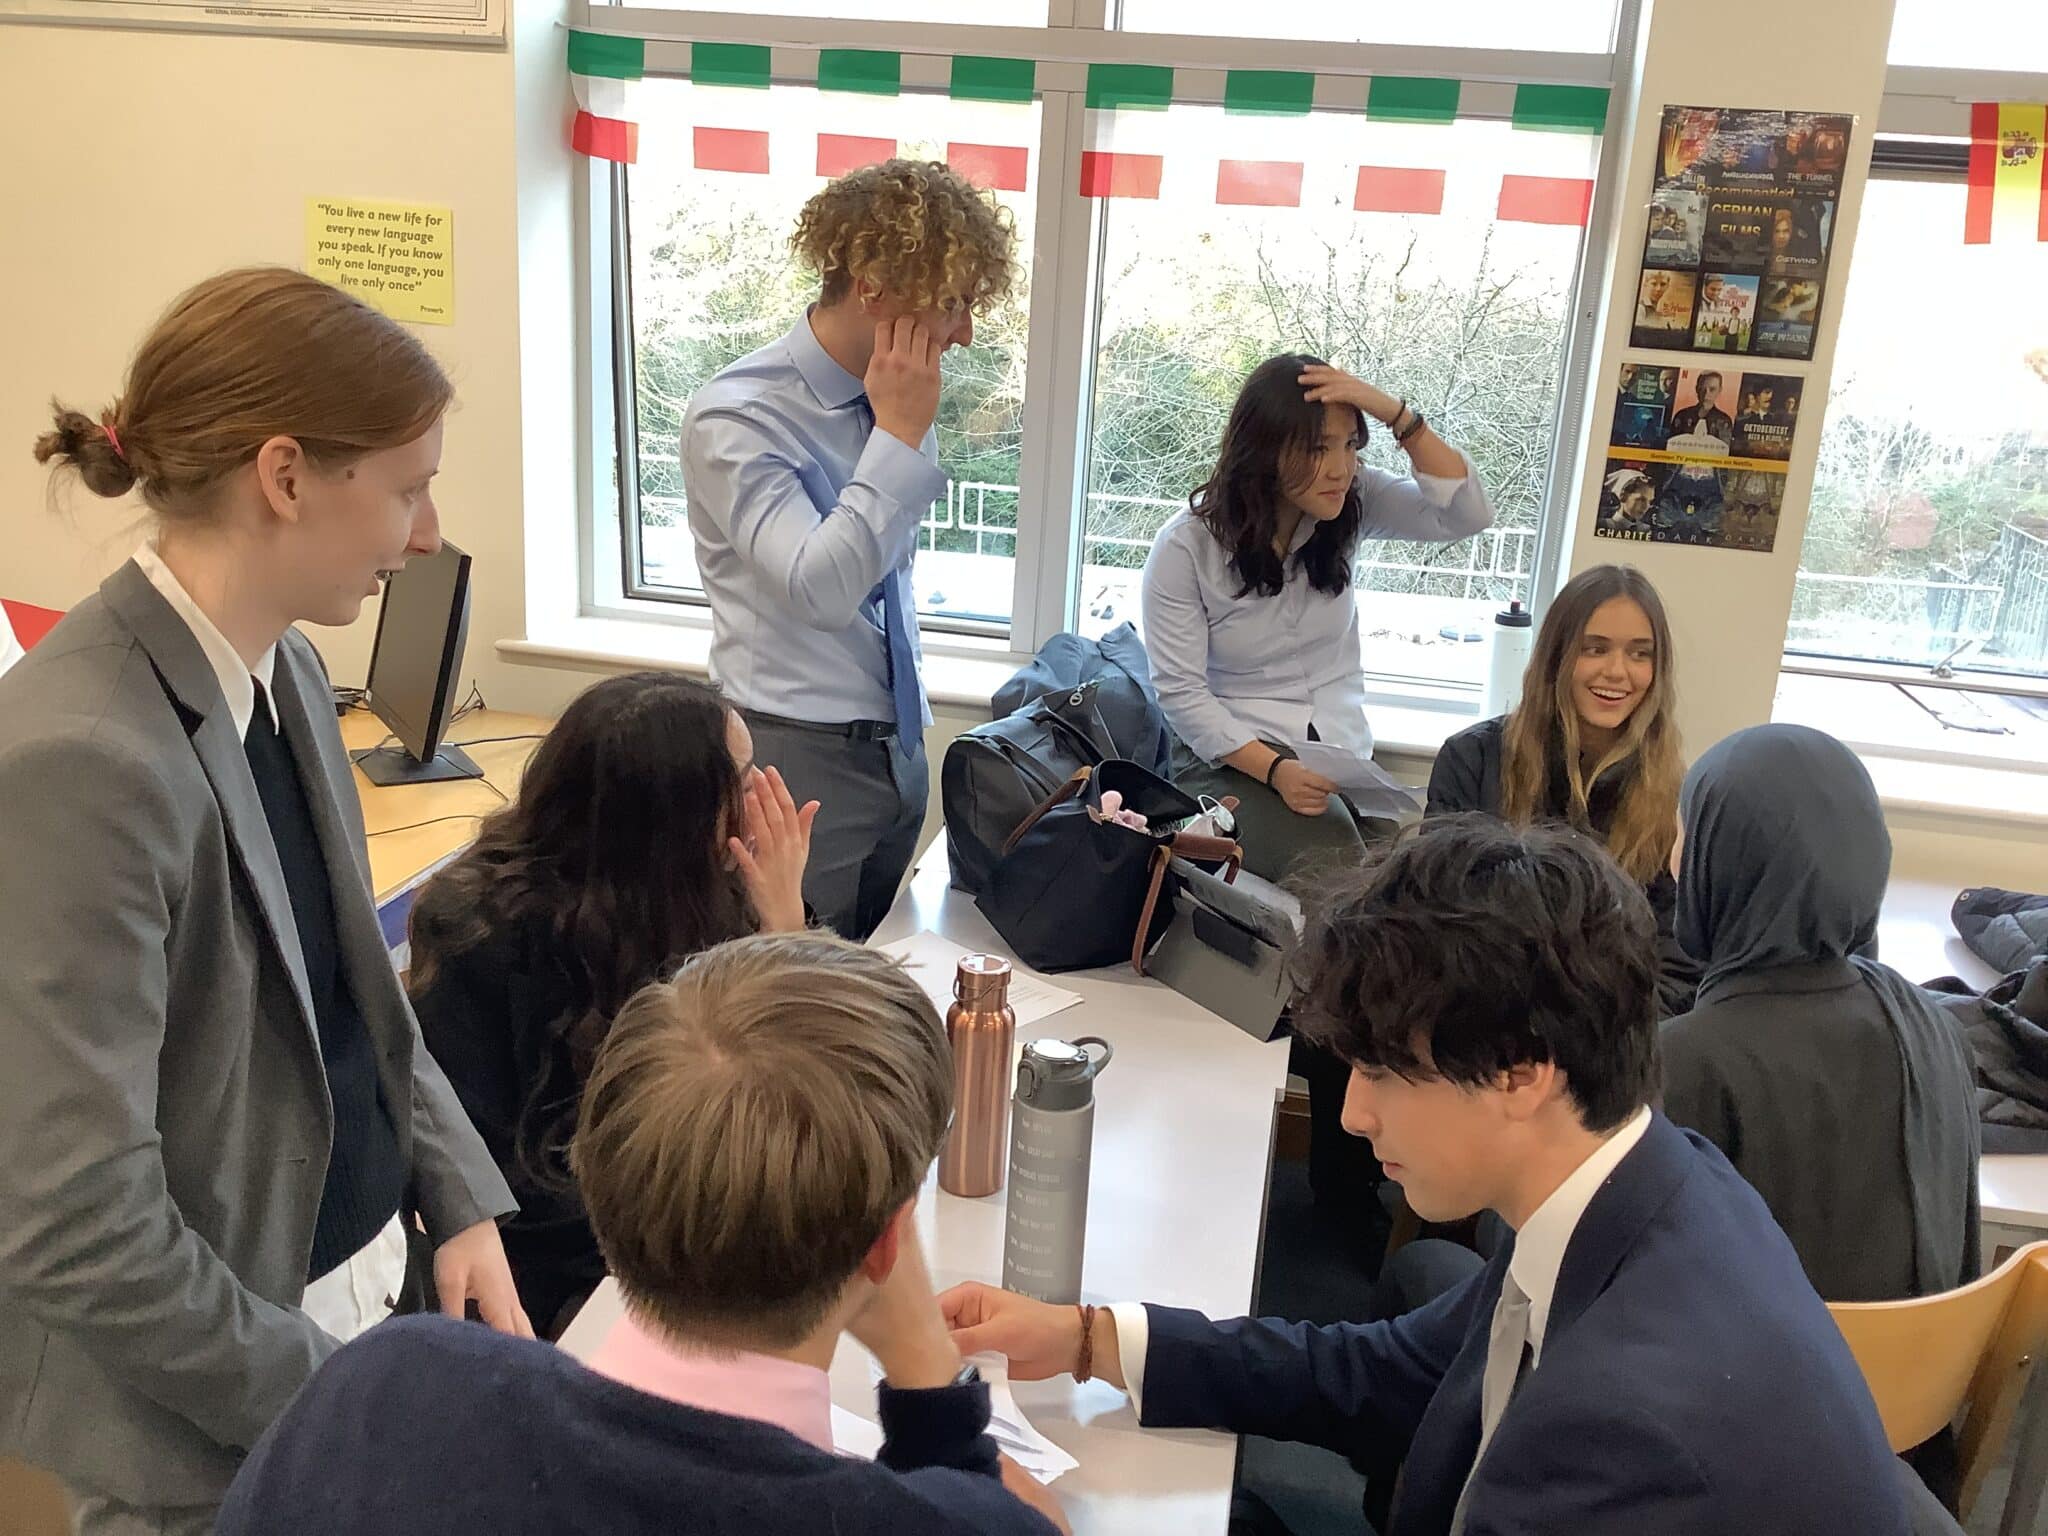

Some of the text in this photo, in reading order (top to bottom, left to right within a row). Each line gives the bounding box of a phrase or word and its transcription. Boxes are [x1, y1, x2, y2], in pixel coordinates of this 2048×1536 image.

[347, 206, 365, 218] live
[368, 211, 375, 220] a
[378, 212, 401, 222] new
[404, 212, 422, 226] life
[425, 214, 442, 227] for
[1711, 203, 1772, 217] GERMAN
[326, 224, 434, 244] every new language
[1720, 224, 1761, 237] FILMS
[318, 240, 443, 260] you speak. If you know
[317, 256, 444, 279] only one language, you
[341, 274, 359, 286] live
[362, 277, 385, 291] only
[420, 305, 444, 314] Proverb
[1657, 532, 1713, 544] DARK
